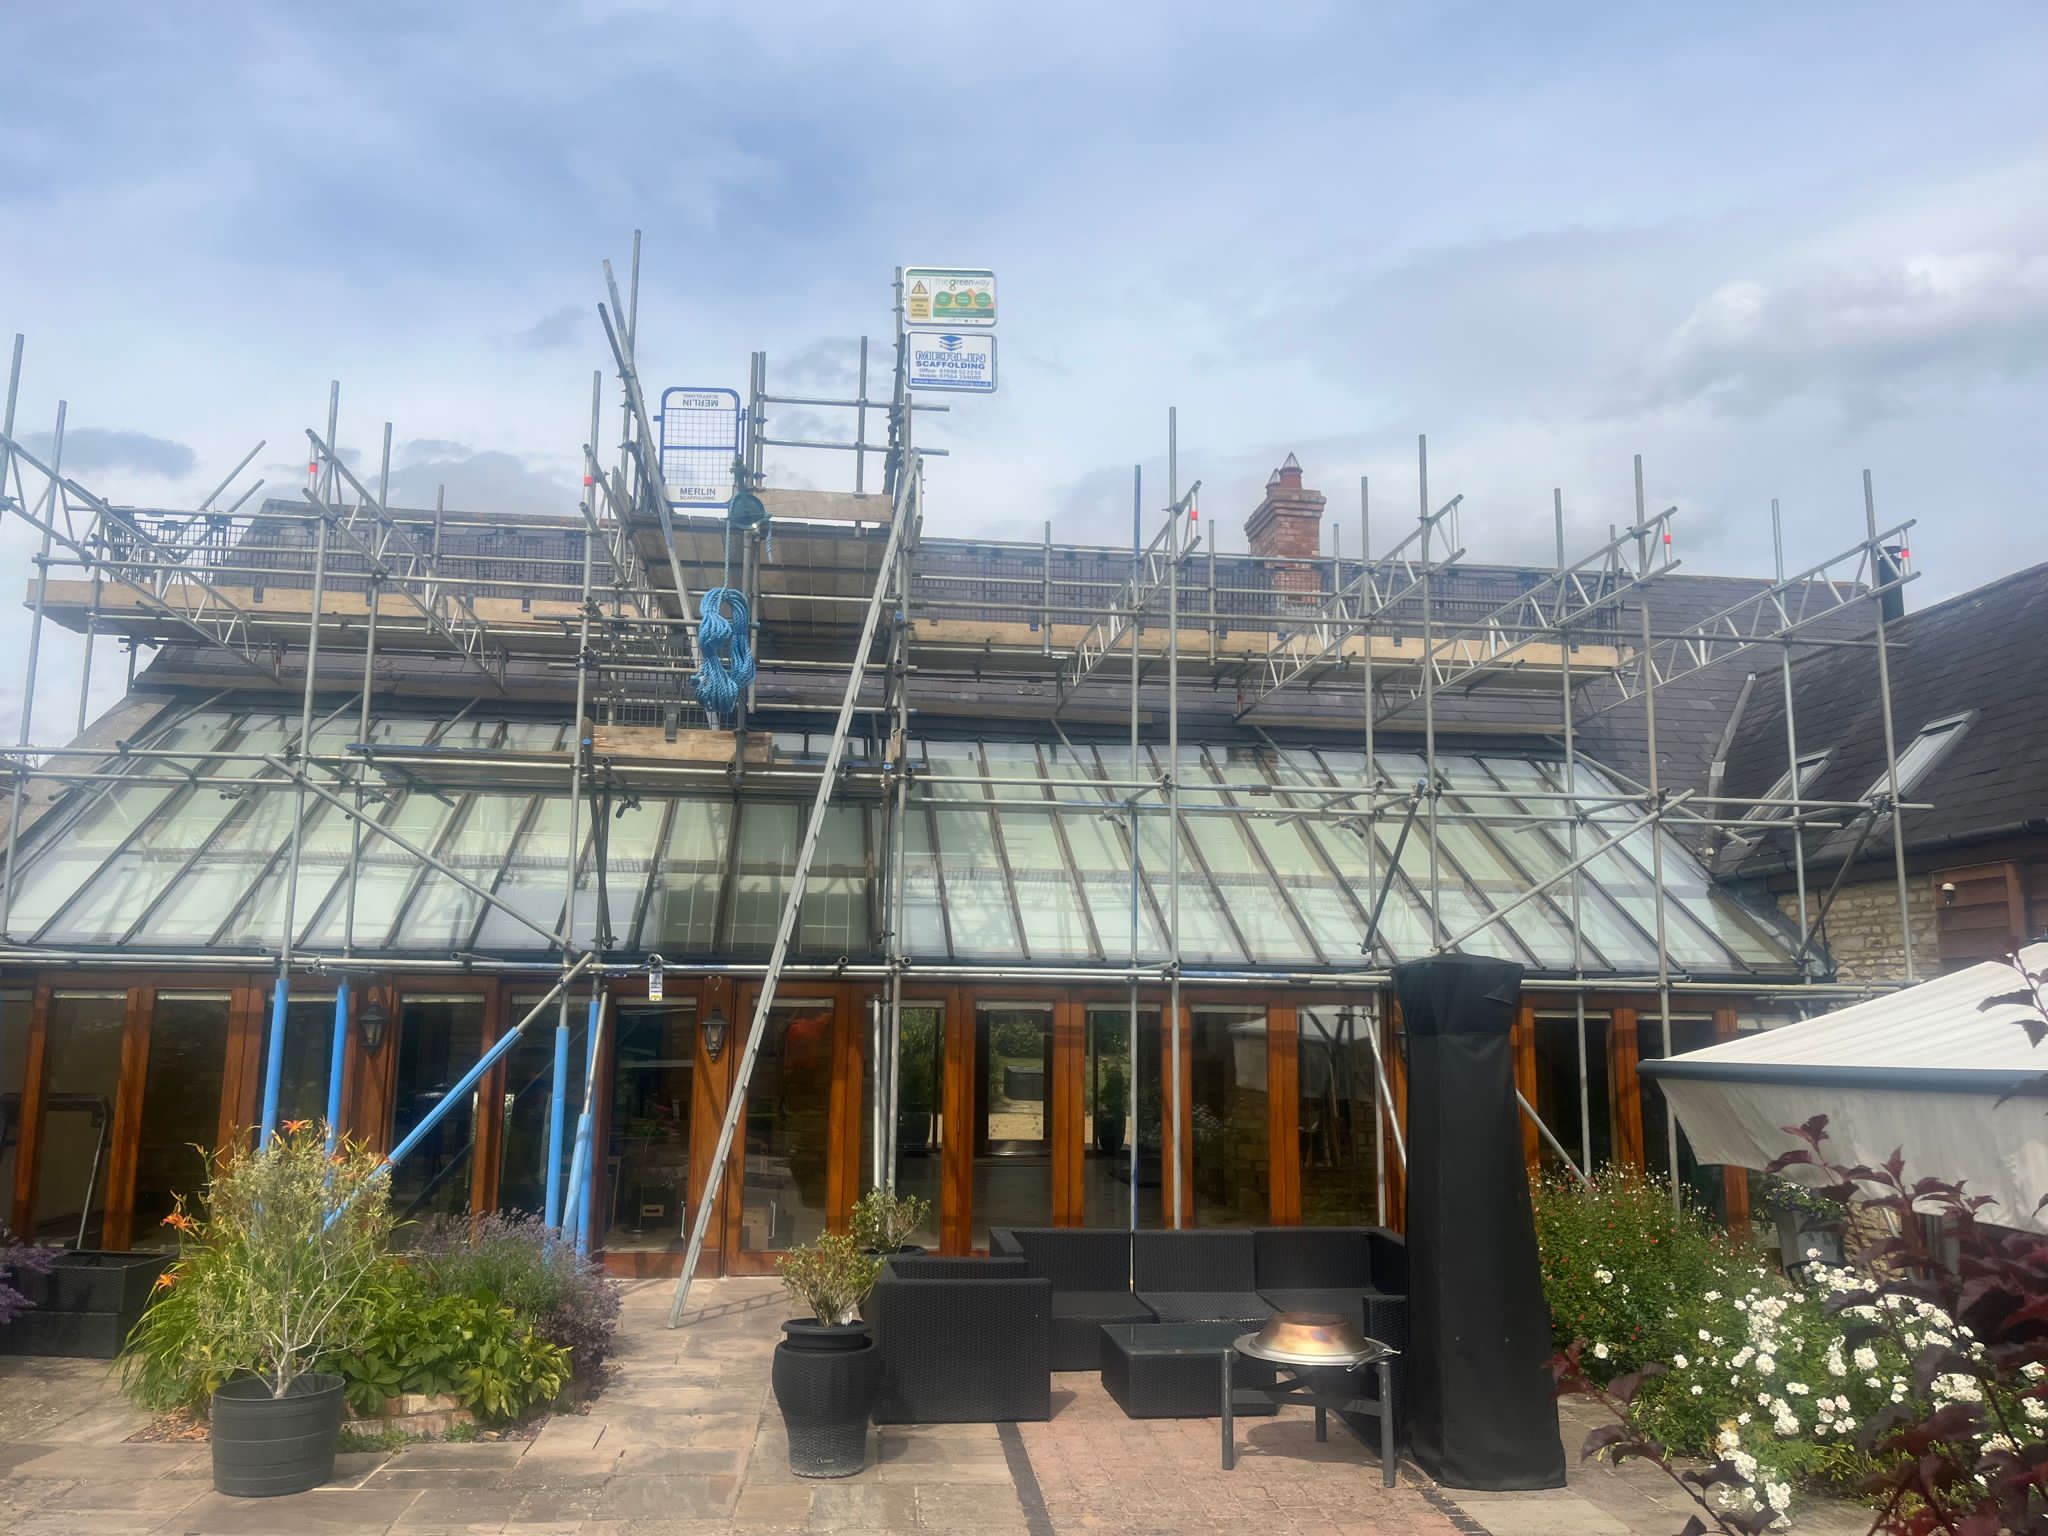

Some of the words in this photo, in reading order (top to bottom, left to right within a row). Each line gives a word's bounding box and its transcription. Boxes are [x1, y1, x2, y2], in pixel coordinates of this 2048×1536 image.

[915, 351, 986, 362] MERLIN
[916, 361, 985, 369] SCAFFOLDING
[680, 488, 716, 496] MERLIN
